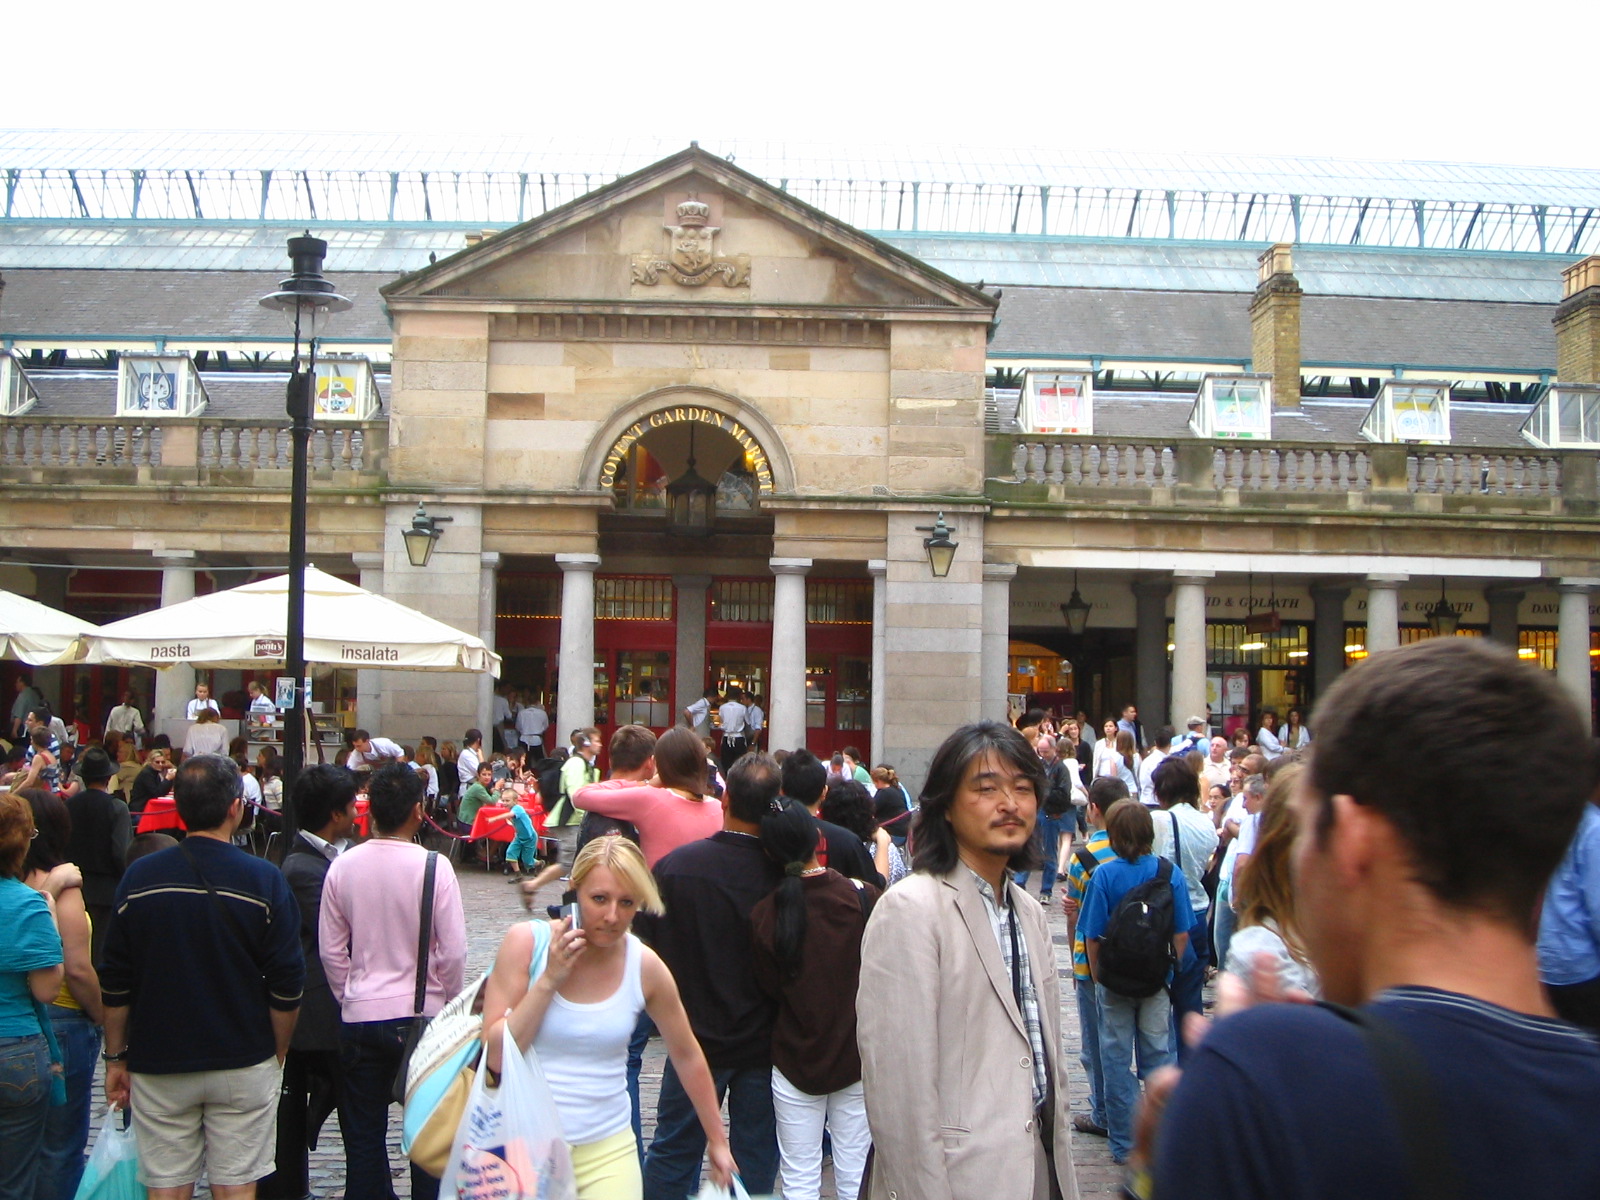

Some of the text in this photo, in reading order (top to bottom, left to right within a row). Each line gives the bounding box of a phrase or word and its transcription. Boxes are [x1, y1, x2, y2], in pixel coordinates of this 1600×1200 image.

[600, 407, 773, 493] COVENT GARDEN MARKET
[1531, 603, 1560, 614] DAVI
[151, 642, 191, 659] pasta
[341, 644, 399, 661] insalata
